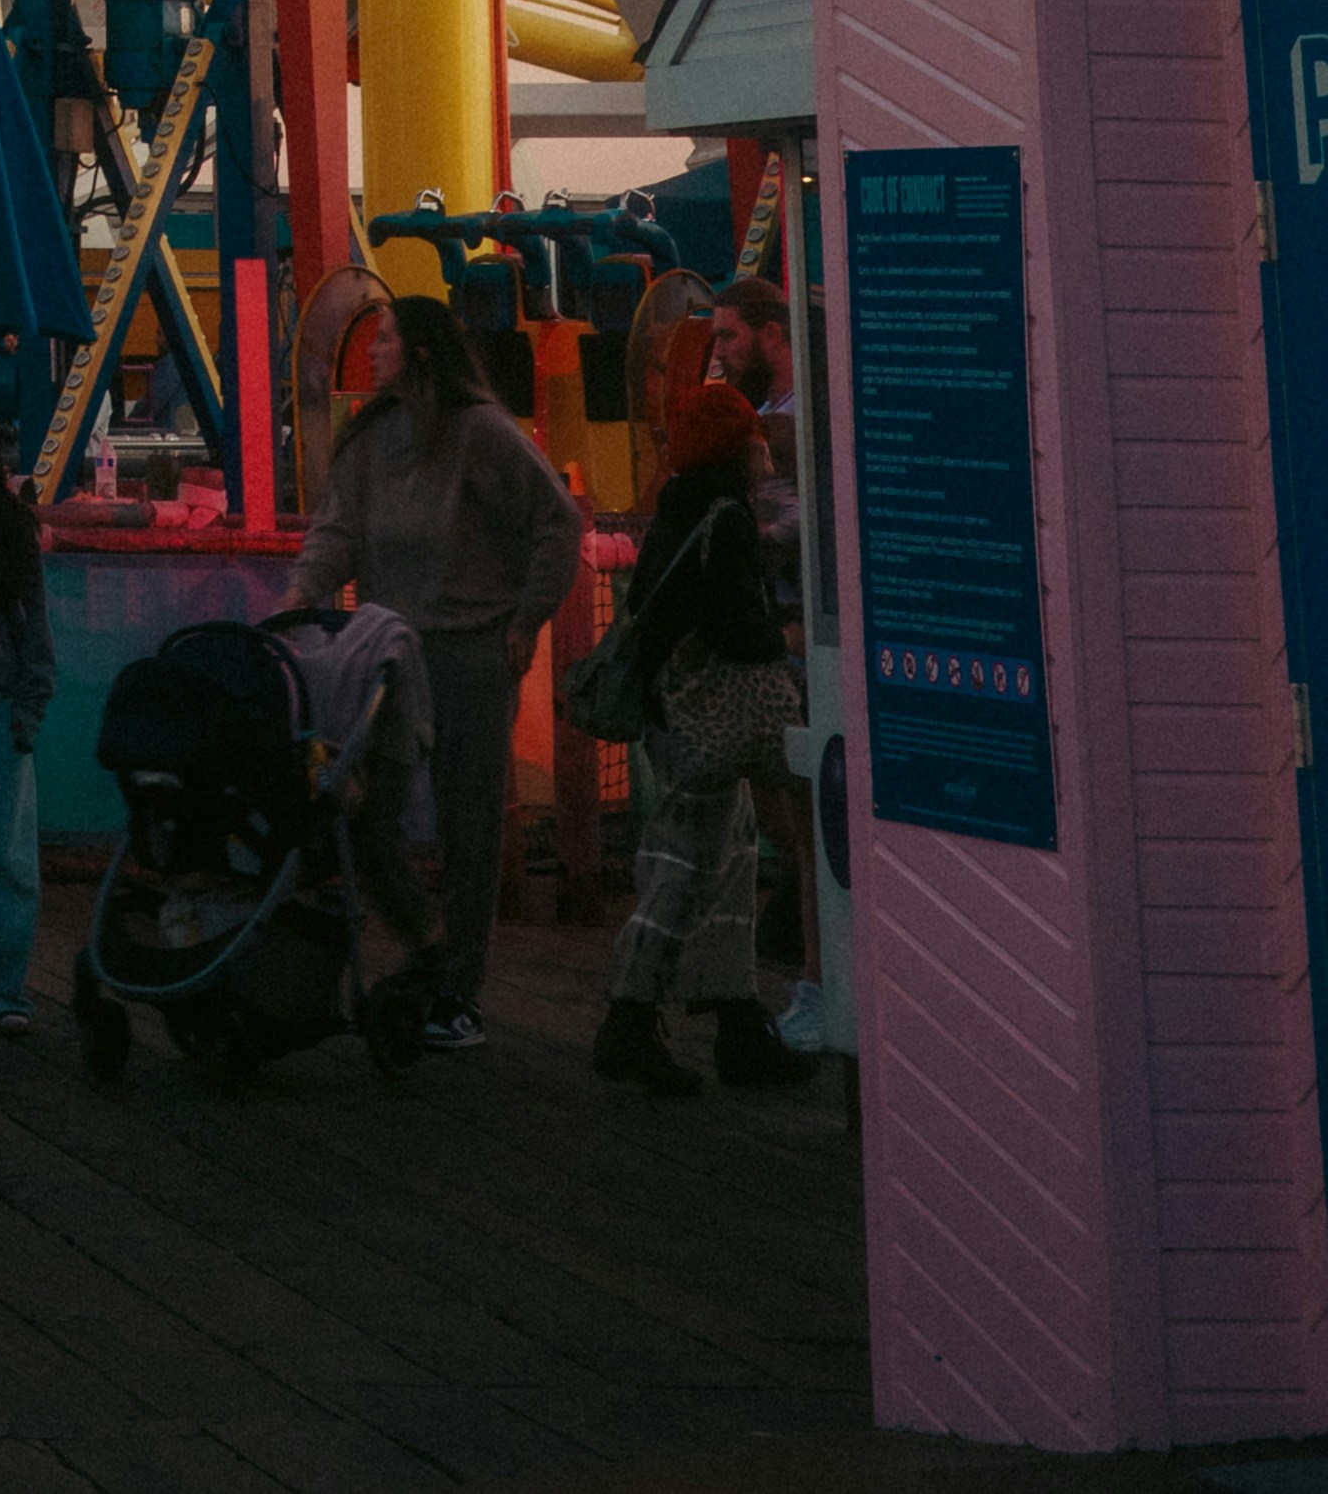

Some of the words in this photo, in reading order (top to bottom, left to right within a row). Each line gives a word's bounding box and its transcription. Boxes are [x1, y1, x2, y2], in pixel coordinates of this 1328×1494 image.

[860, 175, 885, 215] CODE
[886, 175, 898, 215] OF
[900, 174, 946, 214] CONDUCT
